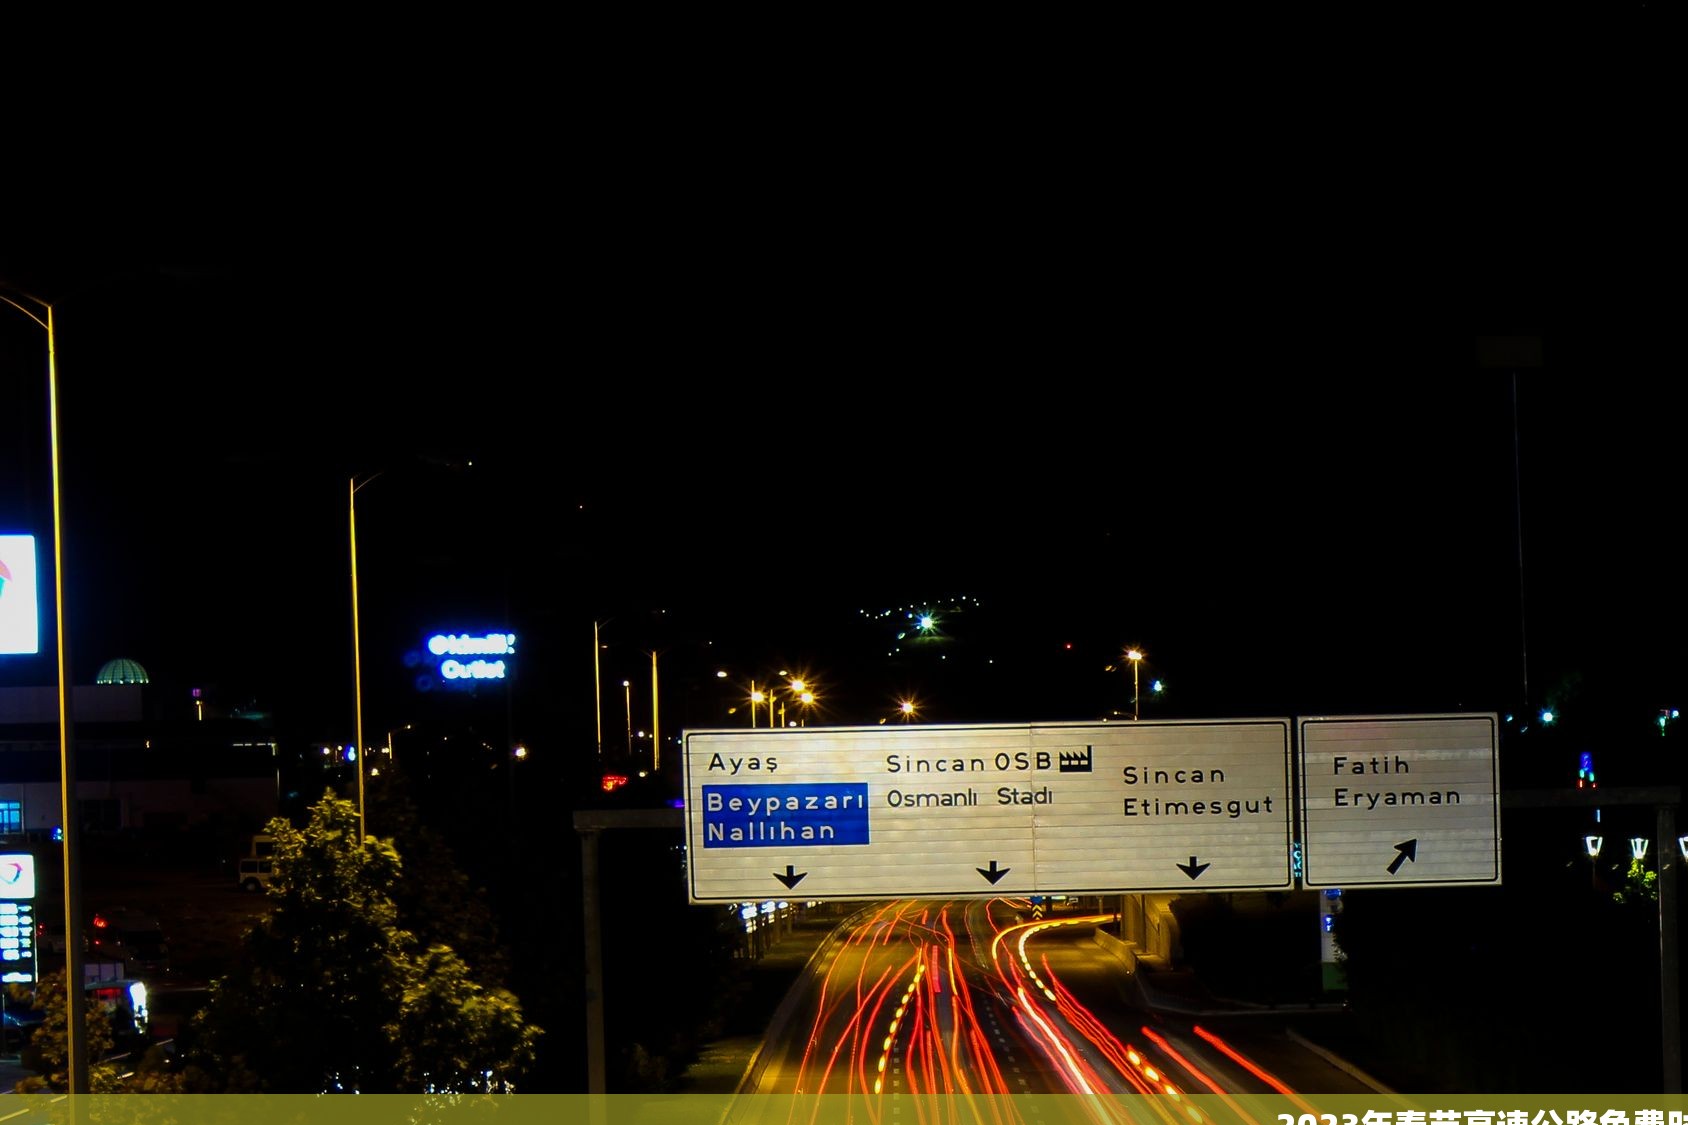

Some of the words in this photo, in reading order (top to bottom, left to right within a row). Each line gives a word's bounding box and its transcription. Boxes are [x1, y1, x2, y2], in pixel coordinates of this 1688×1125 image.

[708, 752, 778, 776] Ayaş
[886, 754, 985, 773] Sincan
[994, 751, 1052, 772] OSB
[1333, 755, 1409, 775] Fatih
[1123, 766, 1225, 785] Sincan
[707, 792, 863, 817] Beypazarı
[887, 787, 977, 808] Osmanlı
[997, 786, 1053, 805] Stadı
[1124, 796, 1273, 819] Etimesgut
[1334, 788, 1460, 811] Eryaman
[708, 821, 834, 841] Nallıhan
